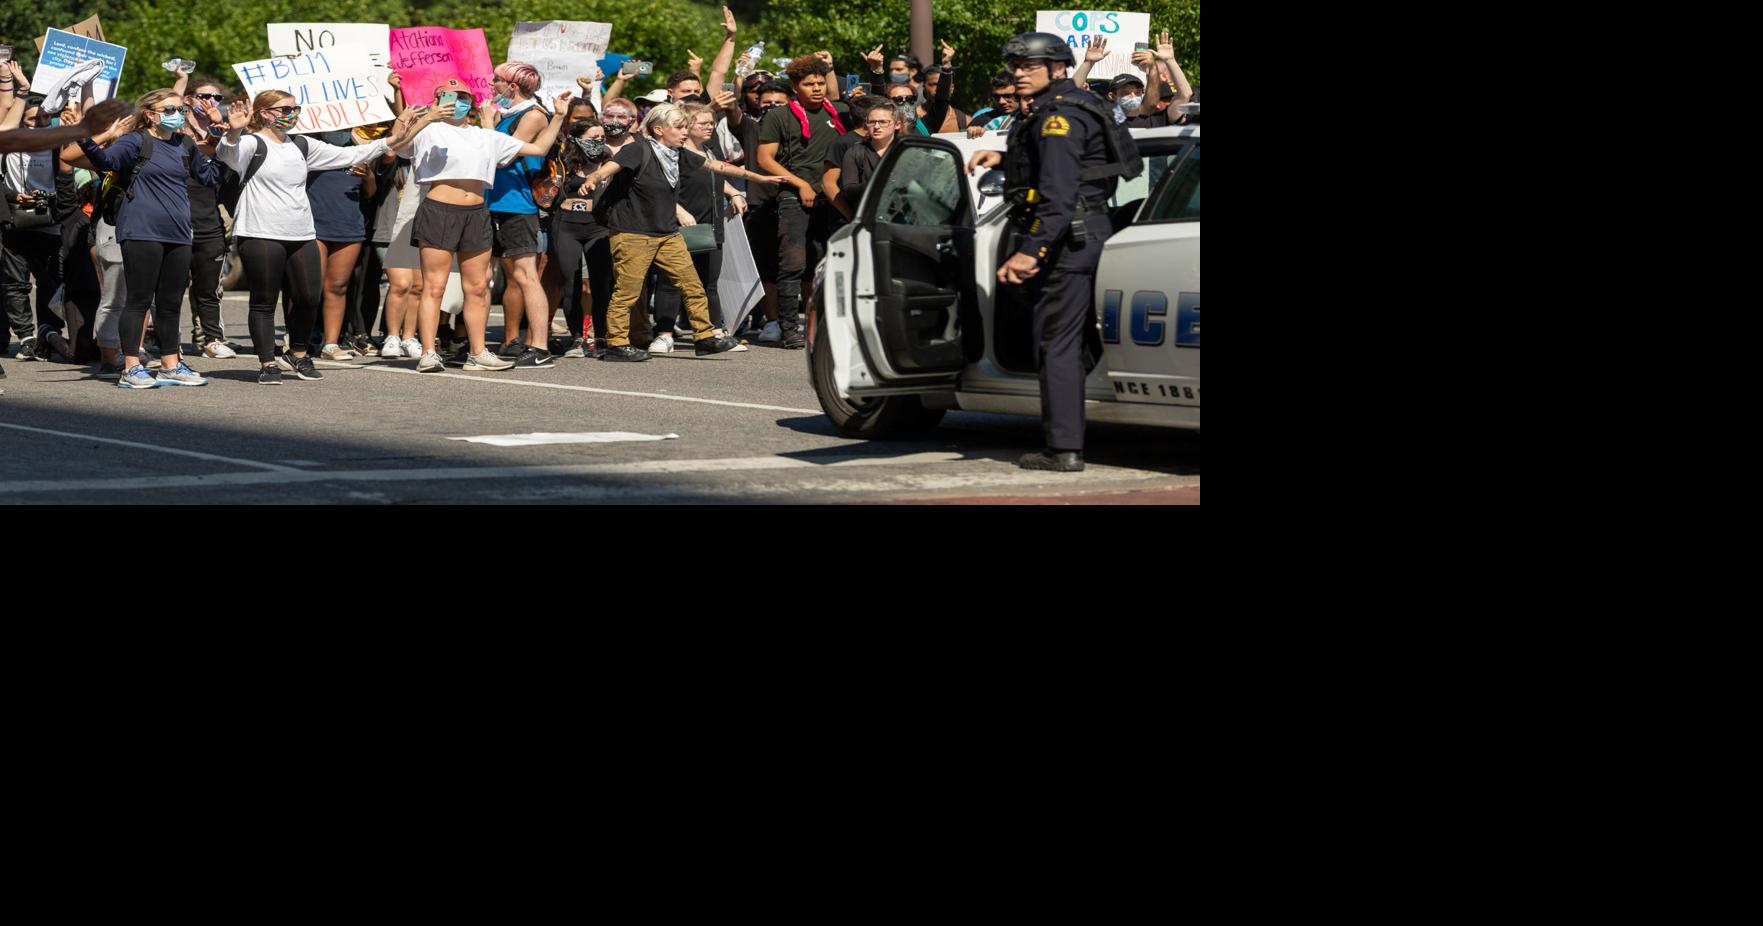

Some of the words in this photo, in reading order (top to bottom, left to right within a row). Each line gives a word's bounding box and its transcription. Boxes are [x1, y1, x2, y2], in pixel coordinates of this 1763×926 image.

[1056, 12, 1120, 34] COPS
[295, 29, 335, 52] NO
[1066, 34, 1100, 49] AR
[240, 51, 331, 86] #BLM
[396, 51, 454, 70] Jefferson
[322, 75, 380, 102] LIVES
[296, 99, 382, 131] URDER
[1103, 289, 1200, 349] ICE
[1113, 380, 1151, 396] NCE
[1157, 384, 1200, 399] 188
